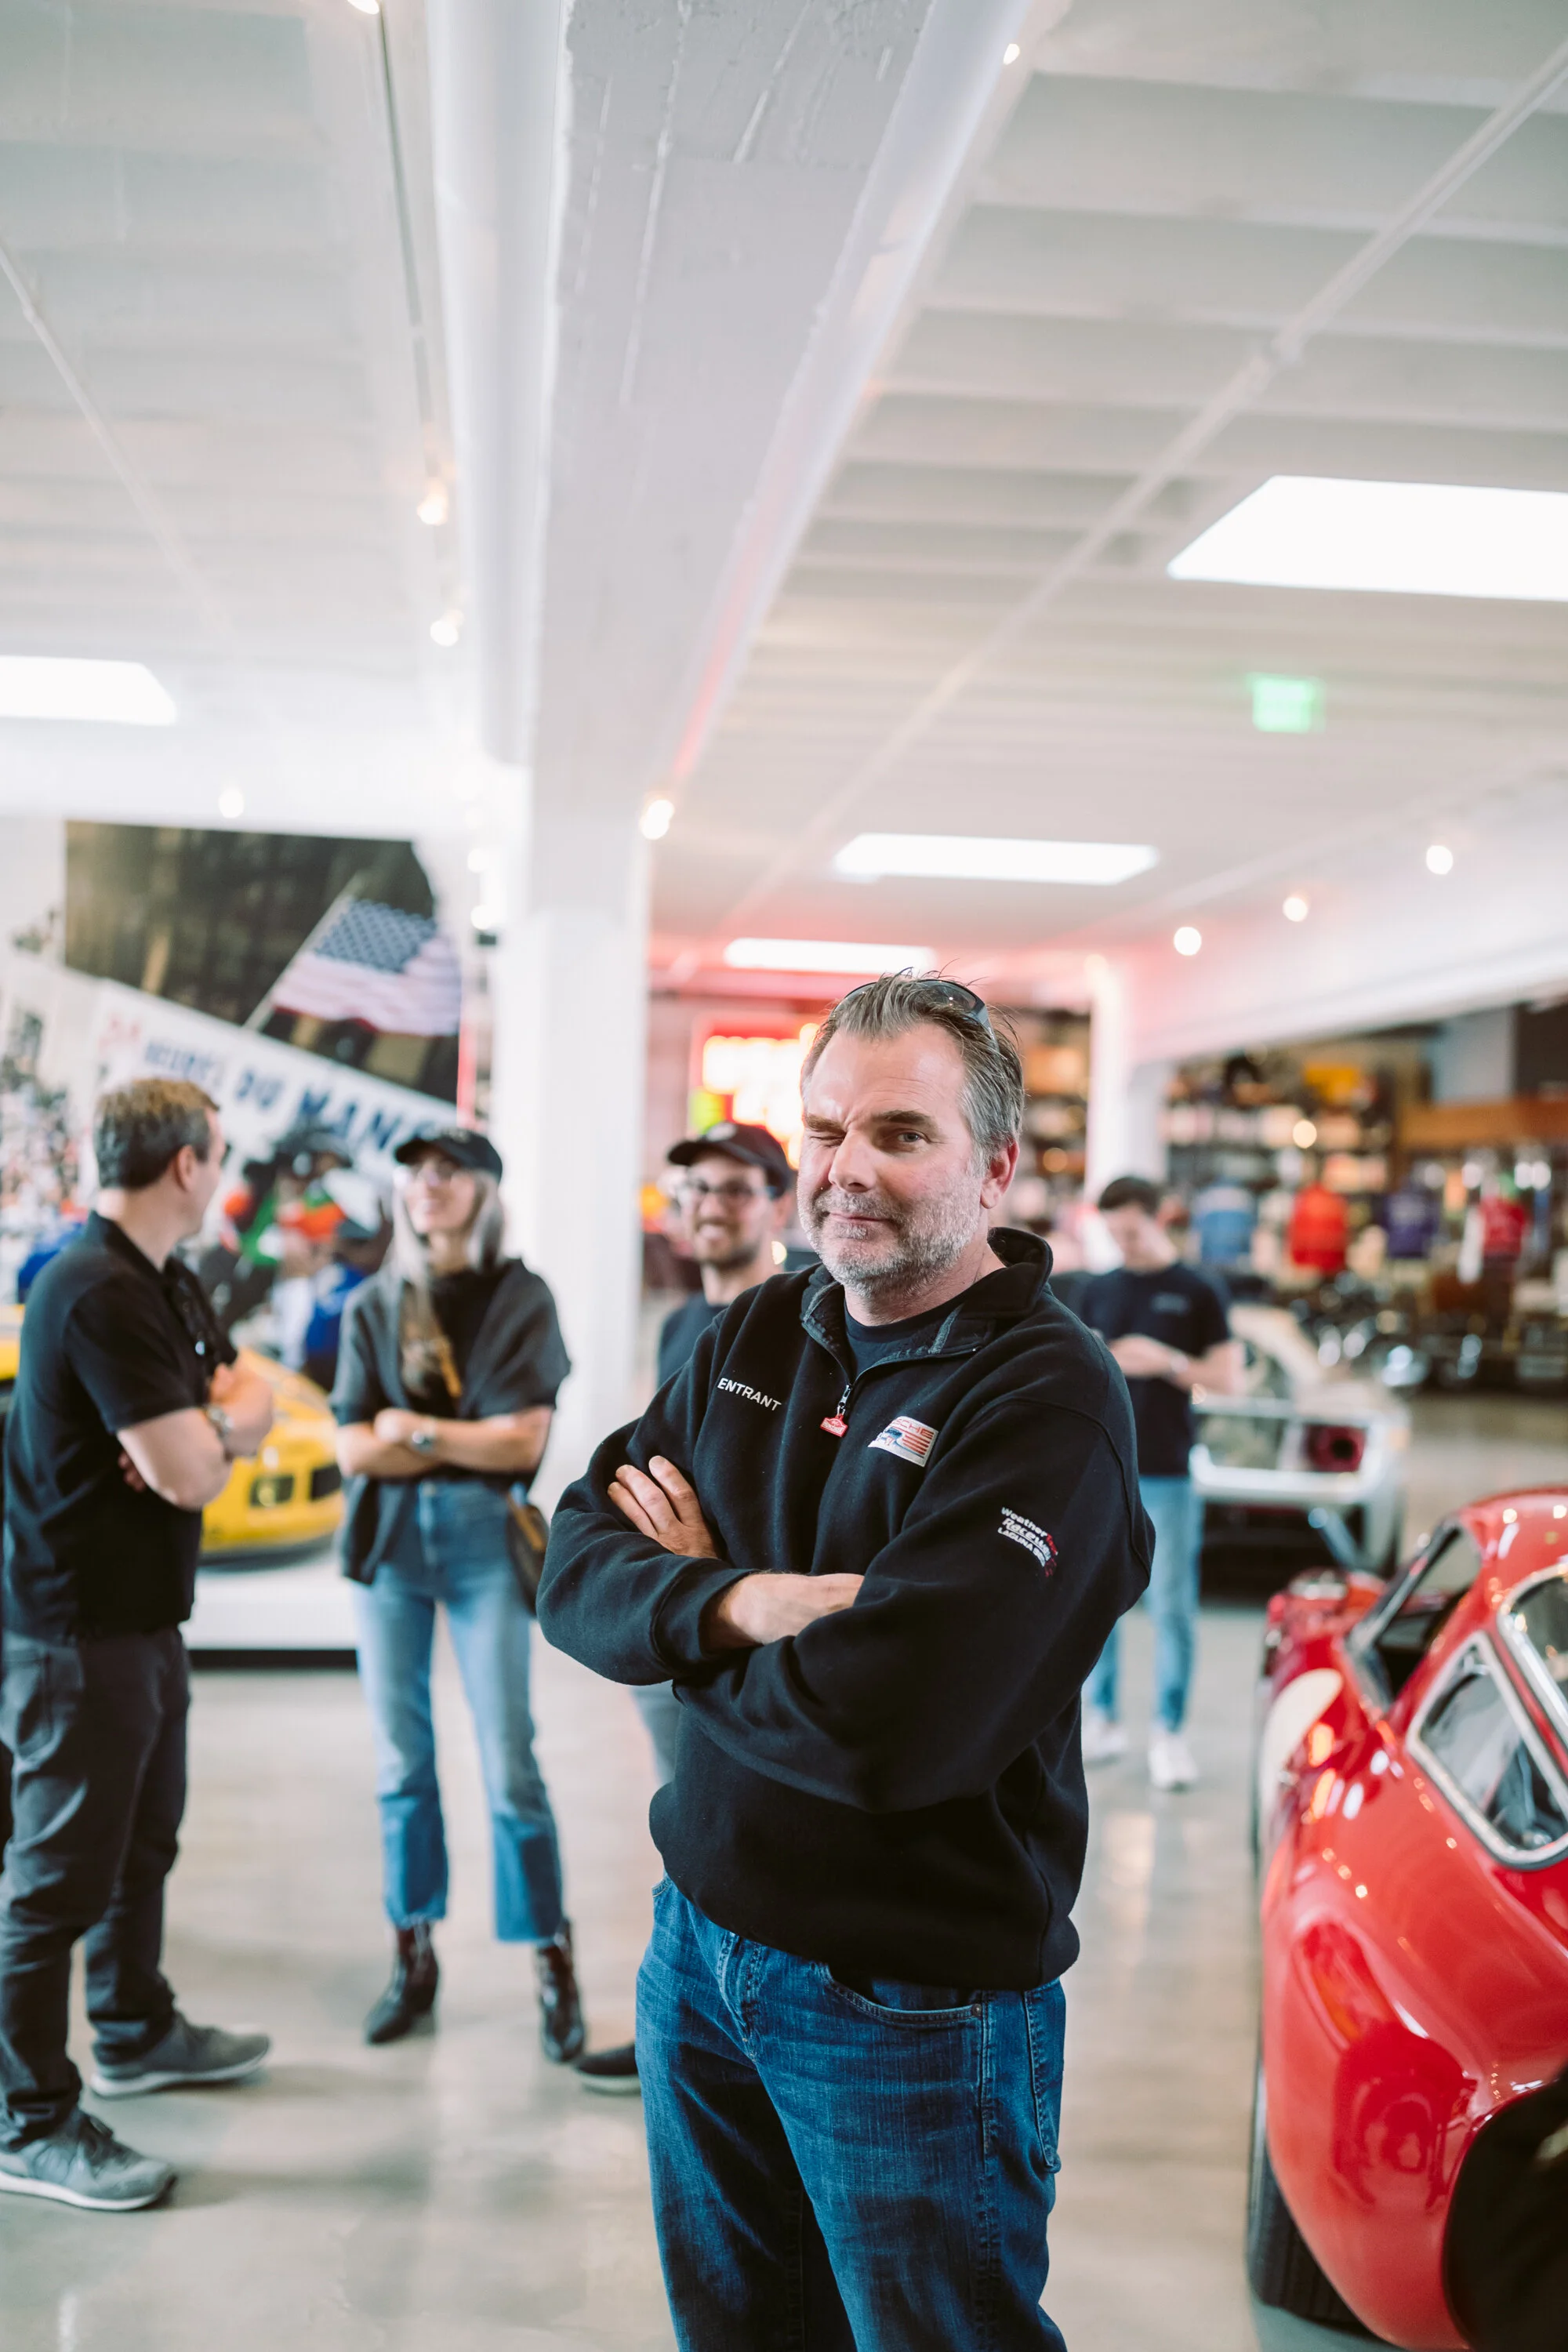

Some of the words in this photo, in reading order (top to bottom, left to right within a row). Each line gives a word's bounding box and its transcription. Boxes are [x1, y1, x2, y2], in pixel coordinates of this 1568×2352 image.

[236, 1069, 283, 1109] DU
[717, 1377, 782, 1410] ENTRANT
[891, 1418, 935, 1439] SCHE
[997, 1526, 1033, 1552] LAGUNA
